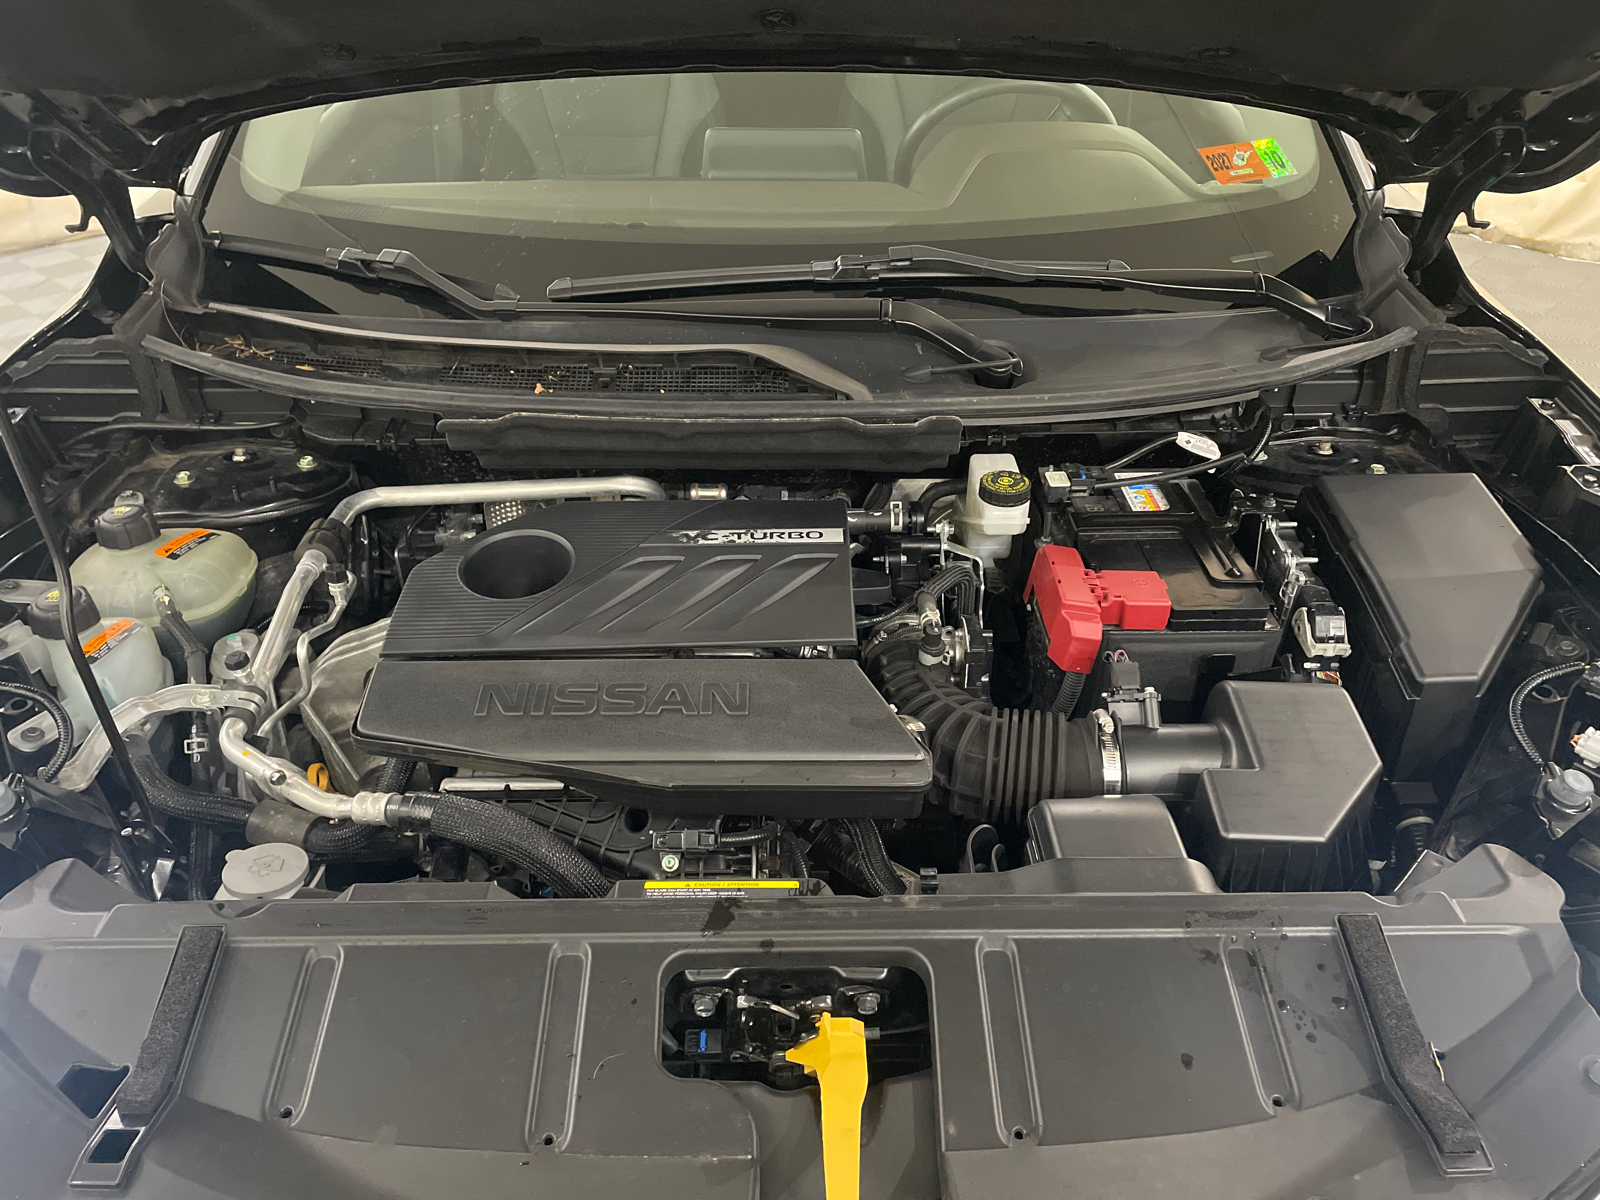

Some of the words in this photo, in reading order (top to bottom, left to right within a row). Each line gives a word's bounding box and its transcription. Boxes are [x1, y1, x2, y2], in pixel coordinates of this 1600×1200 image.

[1205, 152, 1234, 172] 2027
[1264, 150, 1286, 170] 10
[474, 682, 750, 716] NISSAN
